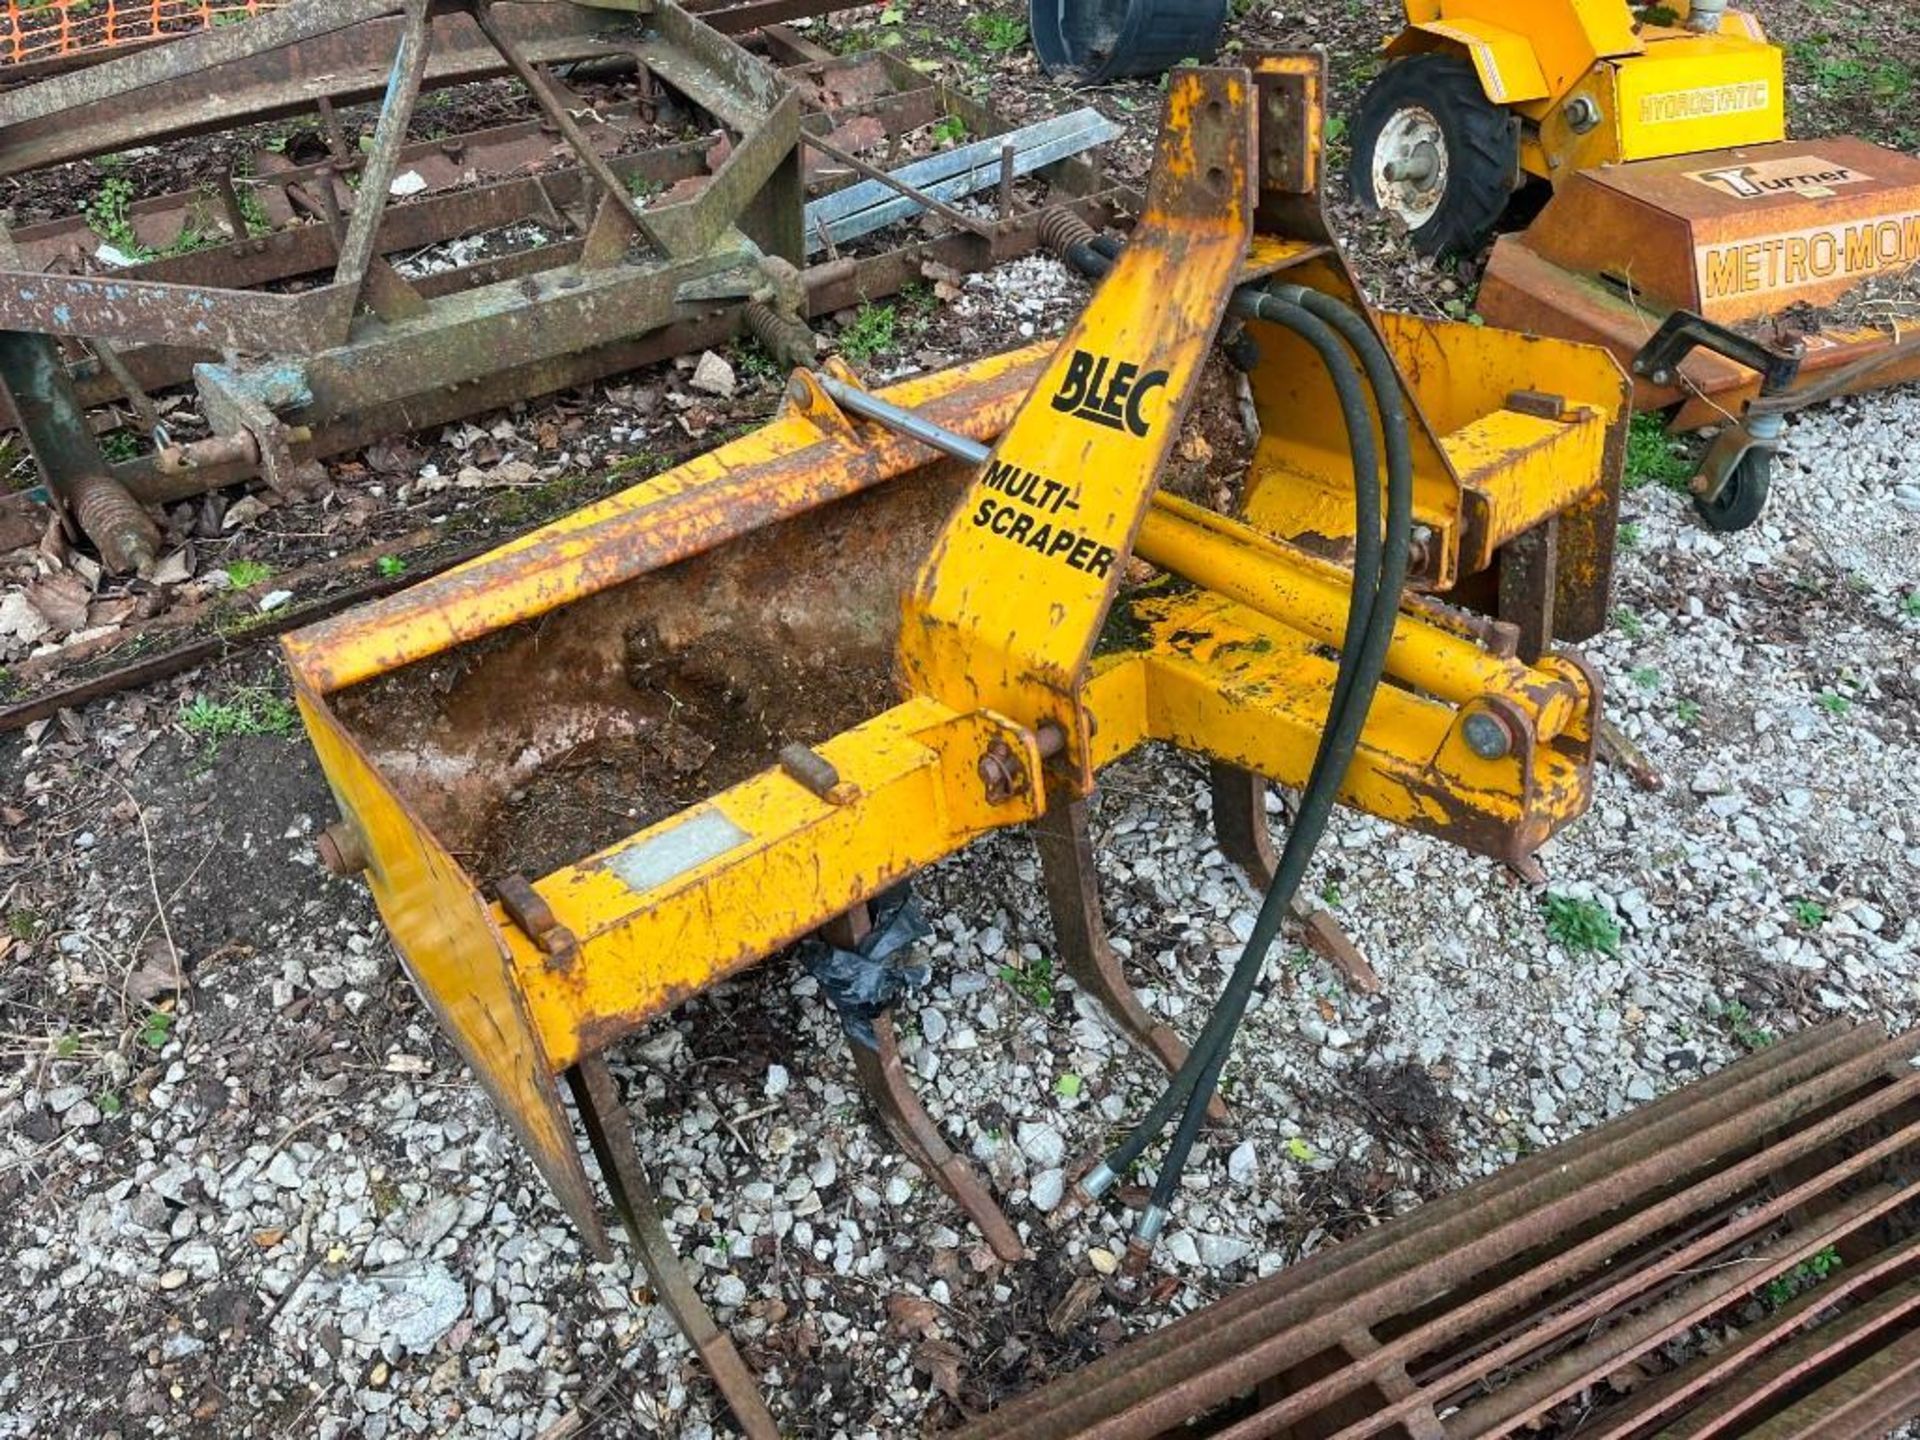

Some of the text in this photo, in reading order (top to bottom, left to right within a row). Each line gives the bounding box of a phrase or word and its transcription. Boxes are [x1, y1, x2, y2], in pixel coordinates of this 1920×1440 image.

[1639, 82, 1766, 122] HYDROSTATIC
[1699, 167, 1849, 197] Turner
[1051, 350, 1169, 437] BLEC
[981, 460, 1081, 514] MULTI-
[973, 499, 1118, 579] SCRAPER
